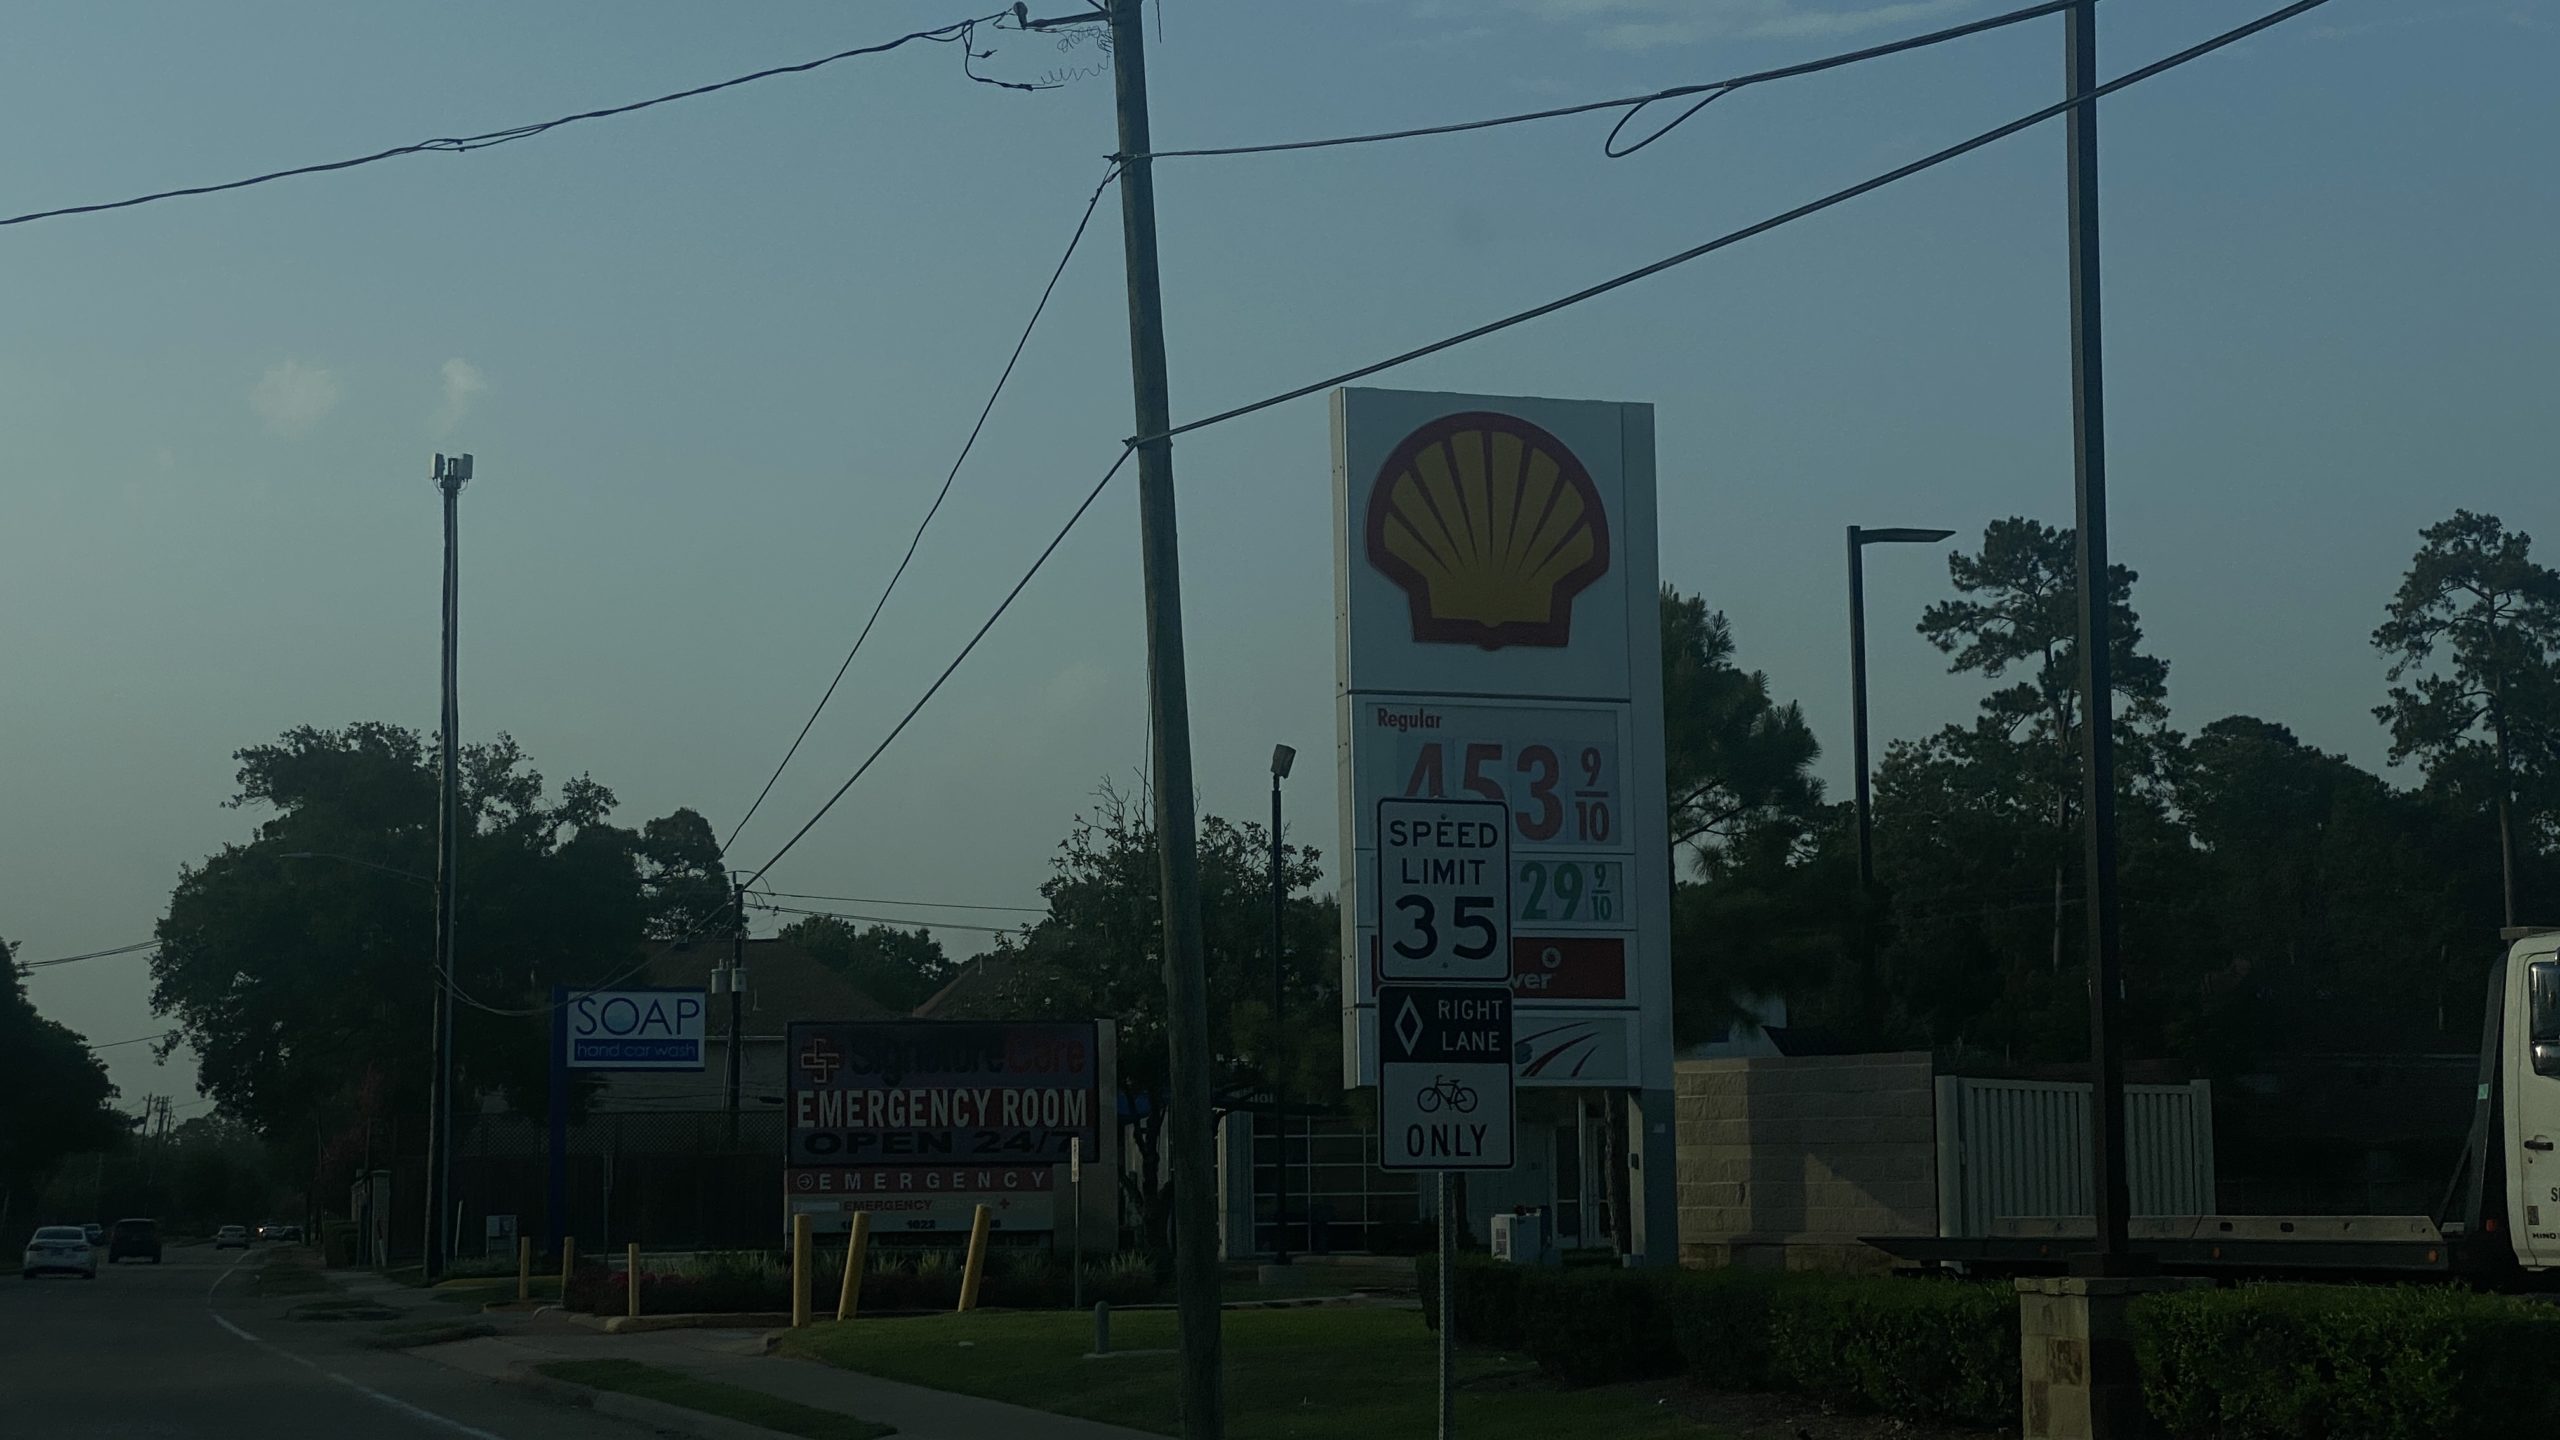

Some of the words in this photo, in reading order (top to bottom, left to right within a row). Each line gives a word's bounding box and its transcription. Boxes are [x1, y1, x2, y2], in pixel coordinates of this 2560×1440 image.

[1377, 708, 1442, 732] Regular
[1389, 820, 1498, 849] SPEED
[1402, 859, 1486, 885] LIMIT
[1519, 862, 1584, 921] 29
[1392, 894, 1499, 961] 35
[1512, 973, 1552, 989] ver
[576, 997, 700, 1036] SOAP
[1438, 1001, 1503, 1021] RIGHT
[576, 1041, 621, 1058] hand
[623, 1044, 649, 1058] car
[654, 1042, 696, 1058] wash
[1442, 1031, 1501, 1052] LANE
[797, 1088, 992, 1129] EMERGENCY
[1001, 1088, 1087, 1128] ROOM
[803, 1131, 954, 1155] OPEN
[971, 1130, 1083, 1154] 24/7
[1406, 1124, 1487, 1158] ONLY
[819, 1171, 1046, 1191] EMERGENCY
[843, 1200, 933, 1213] EMERGENCY
